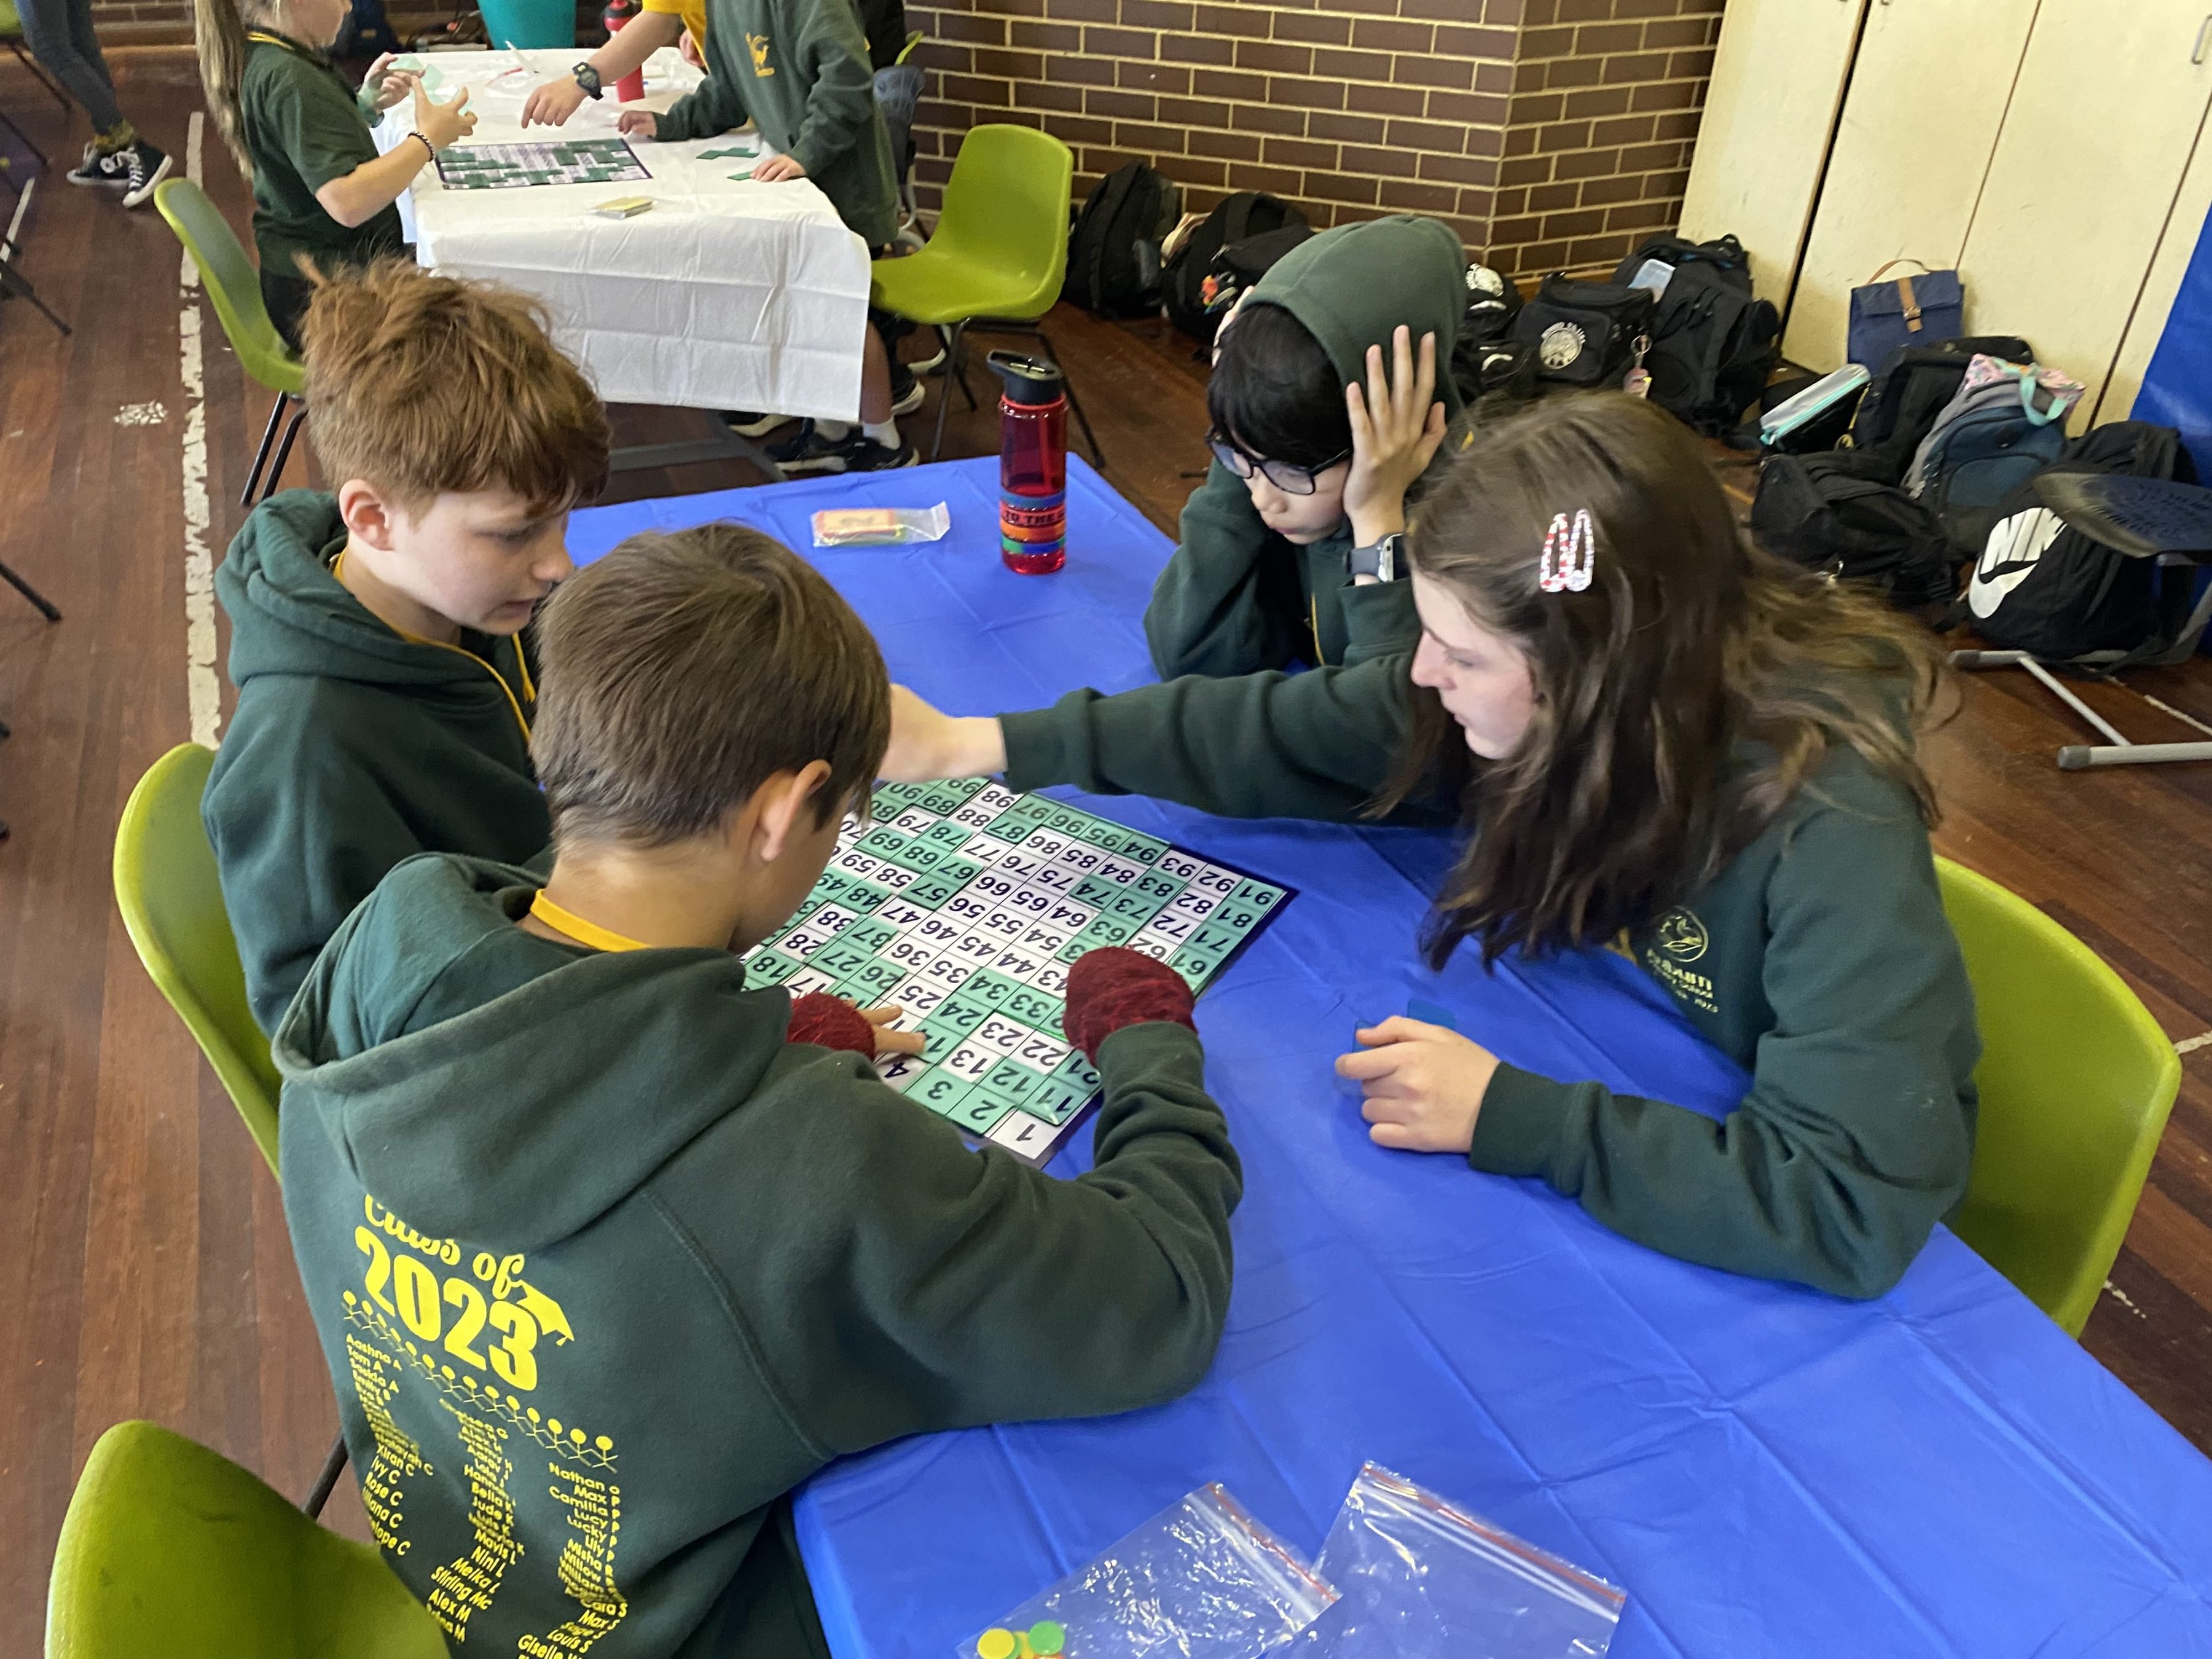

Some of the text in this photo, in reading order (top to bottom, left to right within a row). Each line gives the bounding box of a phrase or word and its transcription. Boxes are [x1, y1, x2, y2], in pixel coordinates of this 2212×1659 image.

[981, 790, 1014, 807] 98
[1013, 802, 1049, 819] 97
[896, 815, 935, 833] 79
[1049, 814, 1085, 833] 96
[869, 832, 904, 850] 69
[930, 826, 965, 845] 78
[1084, 828, 1121, 847] 95
[888, 782, 1252, 928] 81 82 83 84 85 86 87 88 89 90
[903, 845, 939, 865] 68
[963, 843, 1000, 861] 77
[1122, 841, 1158, 861] 94
[841, 853, 876, 873] 59
[936, 861, 975, 879] 67
[1001, 855, 1036, 876] 76
[1160, 857, 1196, 877] 93
[876, 868, 912, 888] 58
[975, 876, 1011, 896] 66
[1036, 869, 1073, 890] 75
[1198, 870, 1235, 892] 92
[847, 887, 886, 906] 48
[909, 882, 948, 901] 57
[1010, 890, 1048, 911] 65
[1075, 882, 1111, 904] 74
[1238, 885, 1274, 905] 91
[880, 906, 920, 924] 47
[947, 897, 986, 919] 56
[1049, 906, 1087, 927] 64
[1114, 898, 1150, 920] 73
[817, 911, 855, 931] 38
[920, 920, 958, 939] 46
[984, 912, 1023, 935] 55
[1089, 920, 1126, 941] 63
[1152, 914, 1190, 938] 72
[785, 933, 825, 955] 28
[850, 927, 893, 948] 37
[956, 936, 997, 956] 45
[1023, 928, 1062, 951] 54
[1128, 936, 1166, 960] 62
[1194, 930, 1230, 952] 71
[820, 951, 864, 972] 27
[890, 943, 930, 966] 36
[996, 952, 1036, 973] 44
[1171, 953, 1207, 975] 61
[752, 955, 788, 978] 18
[860, 965, 901, 989] 26
[927, 960, 969, 983] 35
[897, 985, 942, 1009] 25
[968, 975, 1008, 1000] 34
[938, 1001, 982, 1026] 24
[1009, 994, 1049, 1018] 33
[981, 1021, 1024, 1046] 23
[951, 1049, 987, 1073] 13
[1022, 1038, 1069, 1066] 22
[992, 1065, 1030, 1092] 12
[884, 1059, 1035, 1141] 1 2 3 4
[1037, 1087, 1073, 1112] 11
[473, 1252, 524, 1300] of
[355, 1226, 538, 1390] 2023
[373, 1360, 383, 1373] A
[393, 1359, 402, 1371] A
[389, 1380, 399, 1393] A
[371, 1454, 401, 1484] Ivy C
[405, 1463, 415, 1477] C
[423, 1462, 433, 1476] C
[549, 1462, 605, 1492] Nathan
[365, 1471, 403, 1506] Rose C
[471, 1481, 503, 1507] Bella
[574, 1484, 621, 1507] Max P
[472, 1496, 503, 1521] Jude
[505, 1513, 514, 1527] K
[549, 1486, 621, 1520] Camilla P
[389, 1513, 403, 1529] C
[501, 1524, 511, 1537] K
[574, 1507, 620, 1533] Lucy P
[567, 1515, 618, 1548] Lucky P
[397, 1540, 411, 1556] C
[474, 1528, 509, 1559] Mavis
[509, 1550, 516, 1566] L
[516, 1542, 525, 1556] K
[568, 1538, 602, 1571] Misha
[585, 1534, 615, 1562] Lily P
[471, 1545, 506, 1578] Nini L
[563, 1547, 602, 1583] Willow
[450, 1558, 492, 1588] Meika
[431, 1566, 493, 1610] Stirling Mc
[428, 1588, 458, 1615] Alex
[455, 1604, 472, 1623] M
[618, 1602, 628, 1618] S
[578, 1609, 621, 1630] Max S
[454, 1624, 466, 1644] M
[546, 1629, 594, 1653] Louis S
[517, 1634, 564, 1659] Giselle
